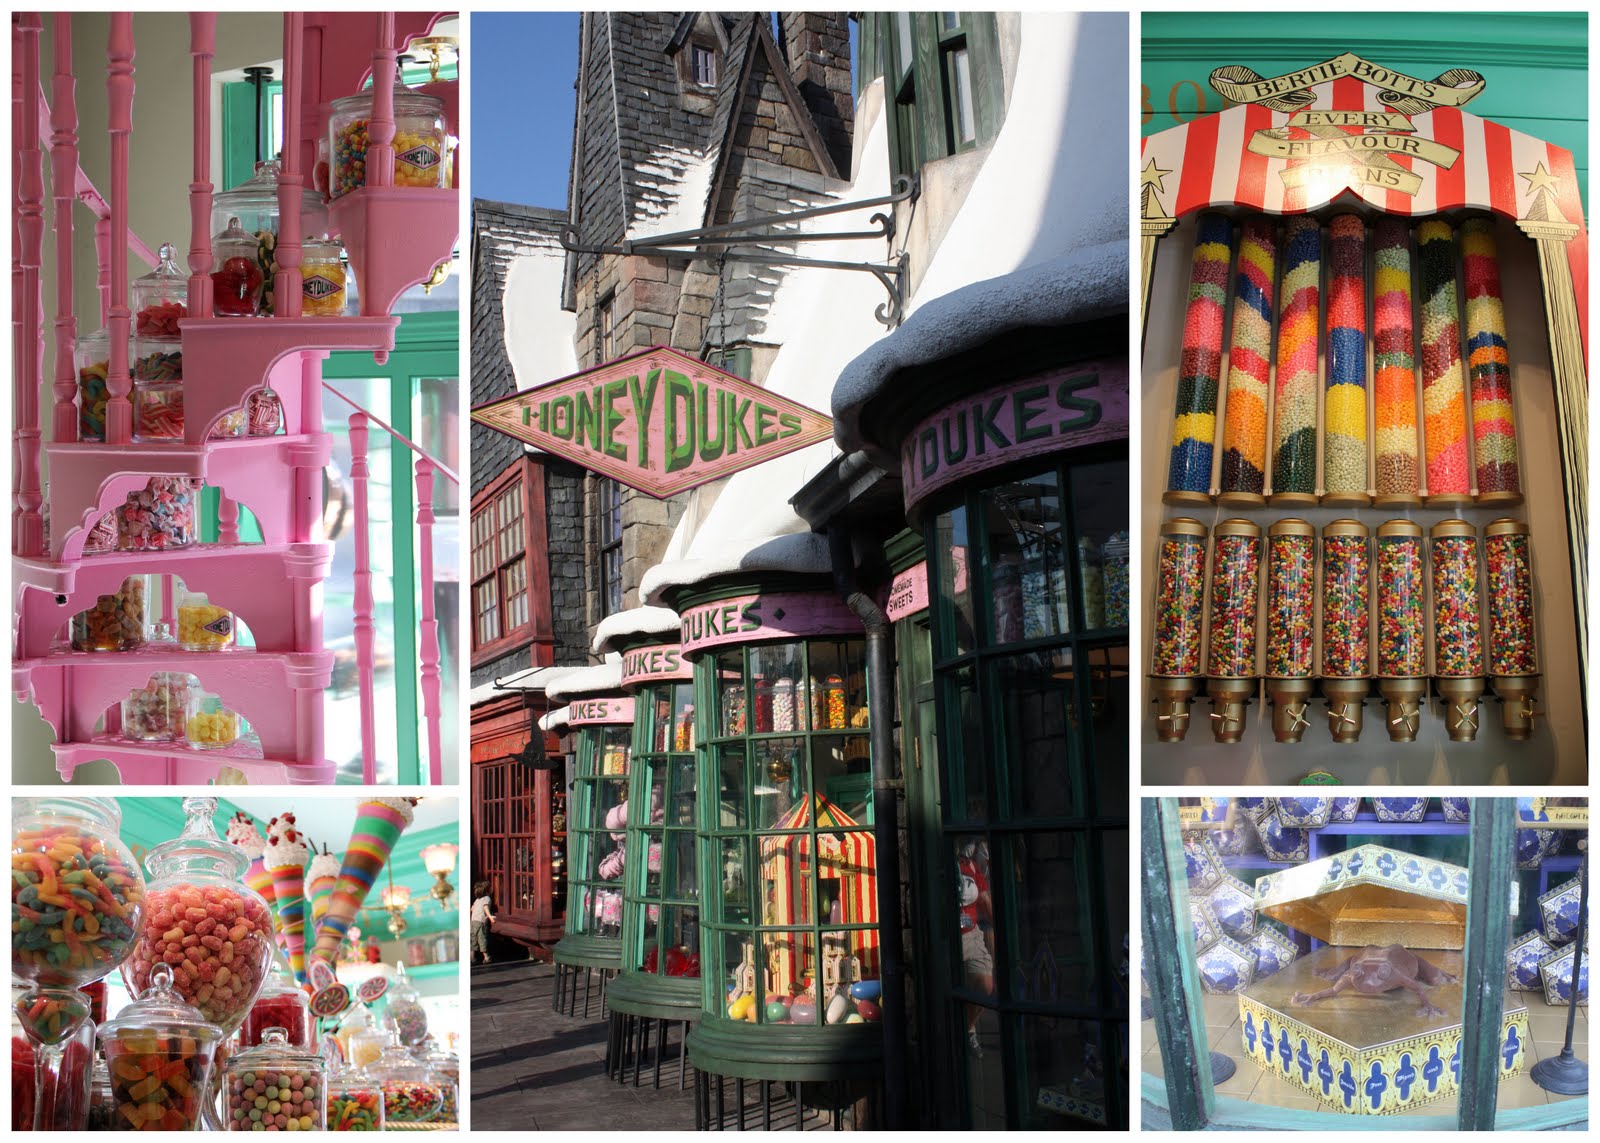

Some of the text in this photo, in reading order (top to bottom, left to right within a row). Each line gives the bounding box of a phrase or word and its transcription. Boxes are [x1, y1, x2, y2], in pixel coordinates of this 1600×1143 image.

[1252, 60, 1437, 98] BERTIE BOTT'S
[1305, 113, 1397, 126] EVERY
[522, 368, 802, 474] HONEYDUKES
[889, 590, 913, 612] SWEETS
